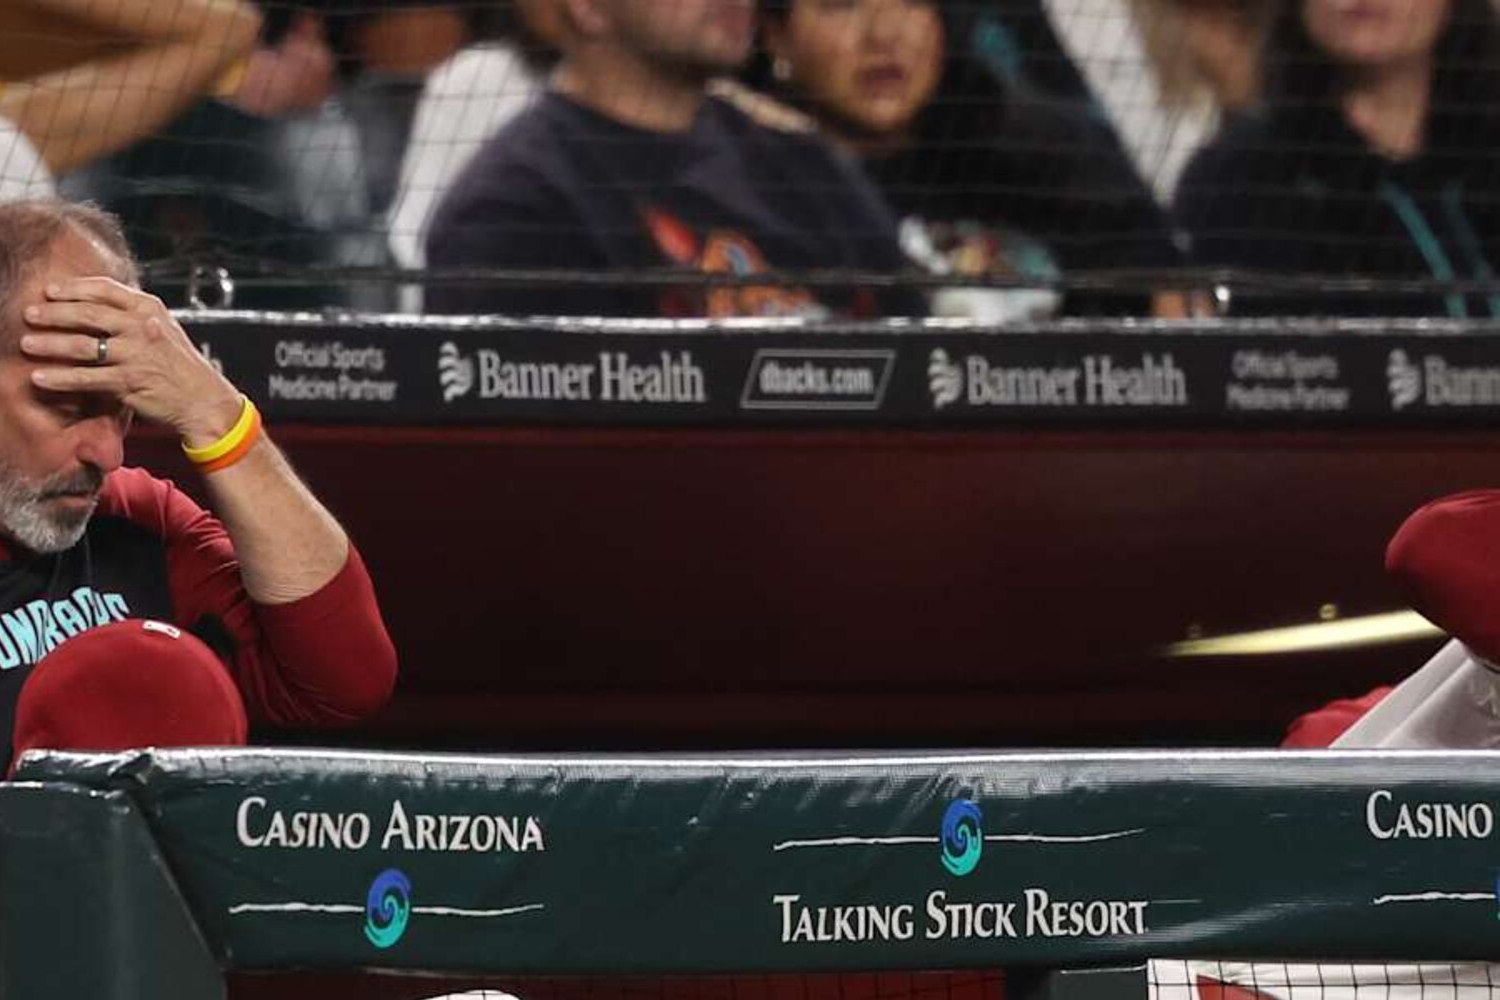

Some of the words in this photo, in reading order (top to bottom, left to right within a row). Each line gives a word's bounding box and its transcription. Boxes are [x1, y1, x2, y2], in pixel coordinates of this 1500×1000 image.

[478, 350, 594, 400] Banner
[600, 350, 705, 403] Health
[967, 355, 1077, 406] Banner
[1083, 353, 1188, 407] Health
[236, 797, 370, 850] CASINO
[381, 800, 544, 852] ARIZONA
[1366, 790, 1493, 839] CASINO
[773, 894, 914, 943] TALKING
[925, 890, 1015, 939] STICK
[1023, 889, 1148, 937] RESORT
